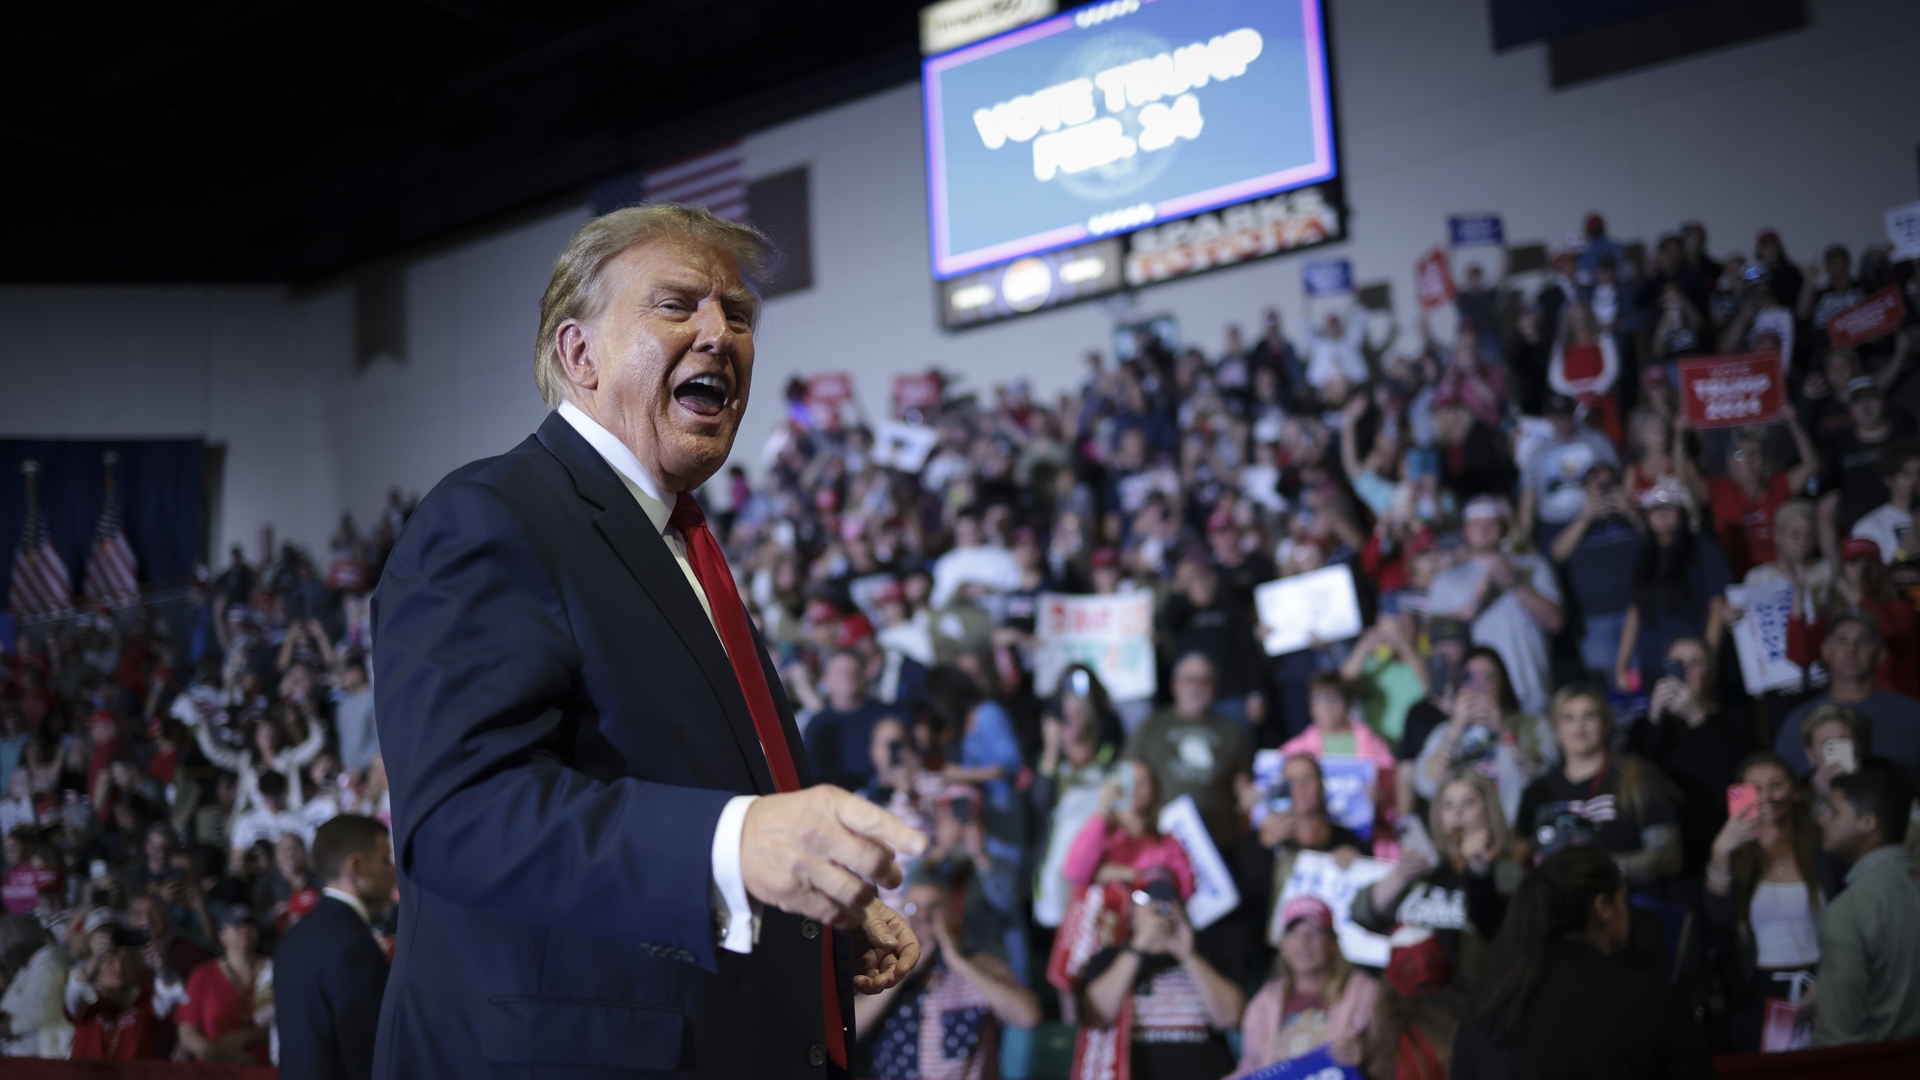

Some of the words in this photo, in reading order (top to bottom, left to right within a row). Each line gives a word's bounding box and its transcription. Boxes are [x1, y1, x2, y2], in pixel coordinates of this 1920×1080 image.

[974, 79, 1095, 149] VOTE
[1095, 29, 1262, 112] TRUMP
[1033, 117, 1136, 180] FEB.
[1138, 94, 1203, 151] 24
[1127, 212, 1338, 286] TOYOTA
[1130, 188, 1325, 251] SPARKS
[1692, 374, 1771, 402] TRUMP
[1704, 396, 1762, 420] 2024
